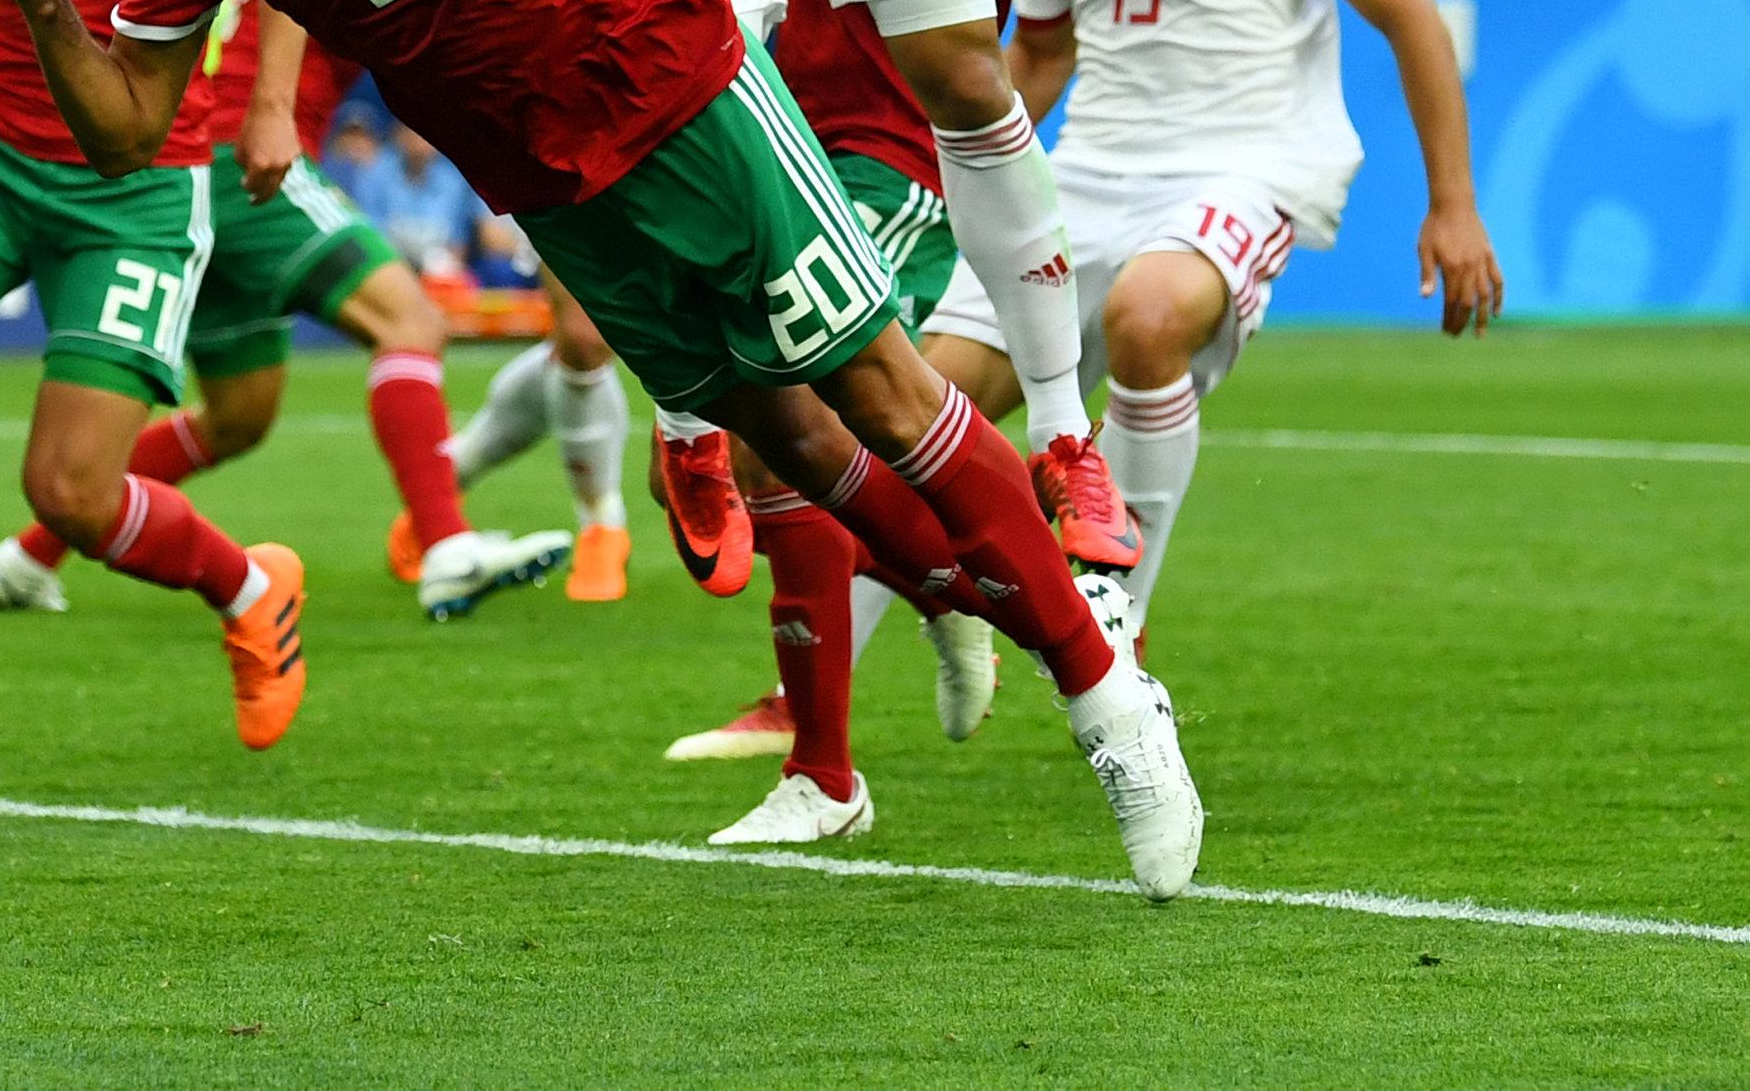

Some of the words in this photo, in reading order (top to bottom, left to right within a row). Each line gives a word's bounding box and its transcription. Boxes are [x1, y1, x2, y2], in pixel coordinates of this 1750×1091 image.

[1196, 203, 1253, 267] 19
[97, 257, 182, 354] 21
[763, 234, 870, 363] 20
